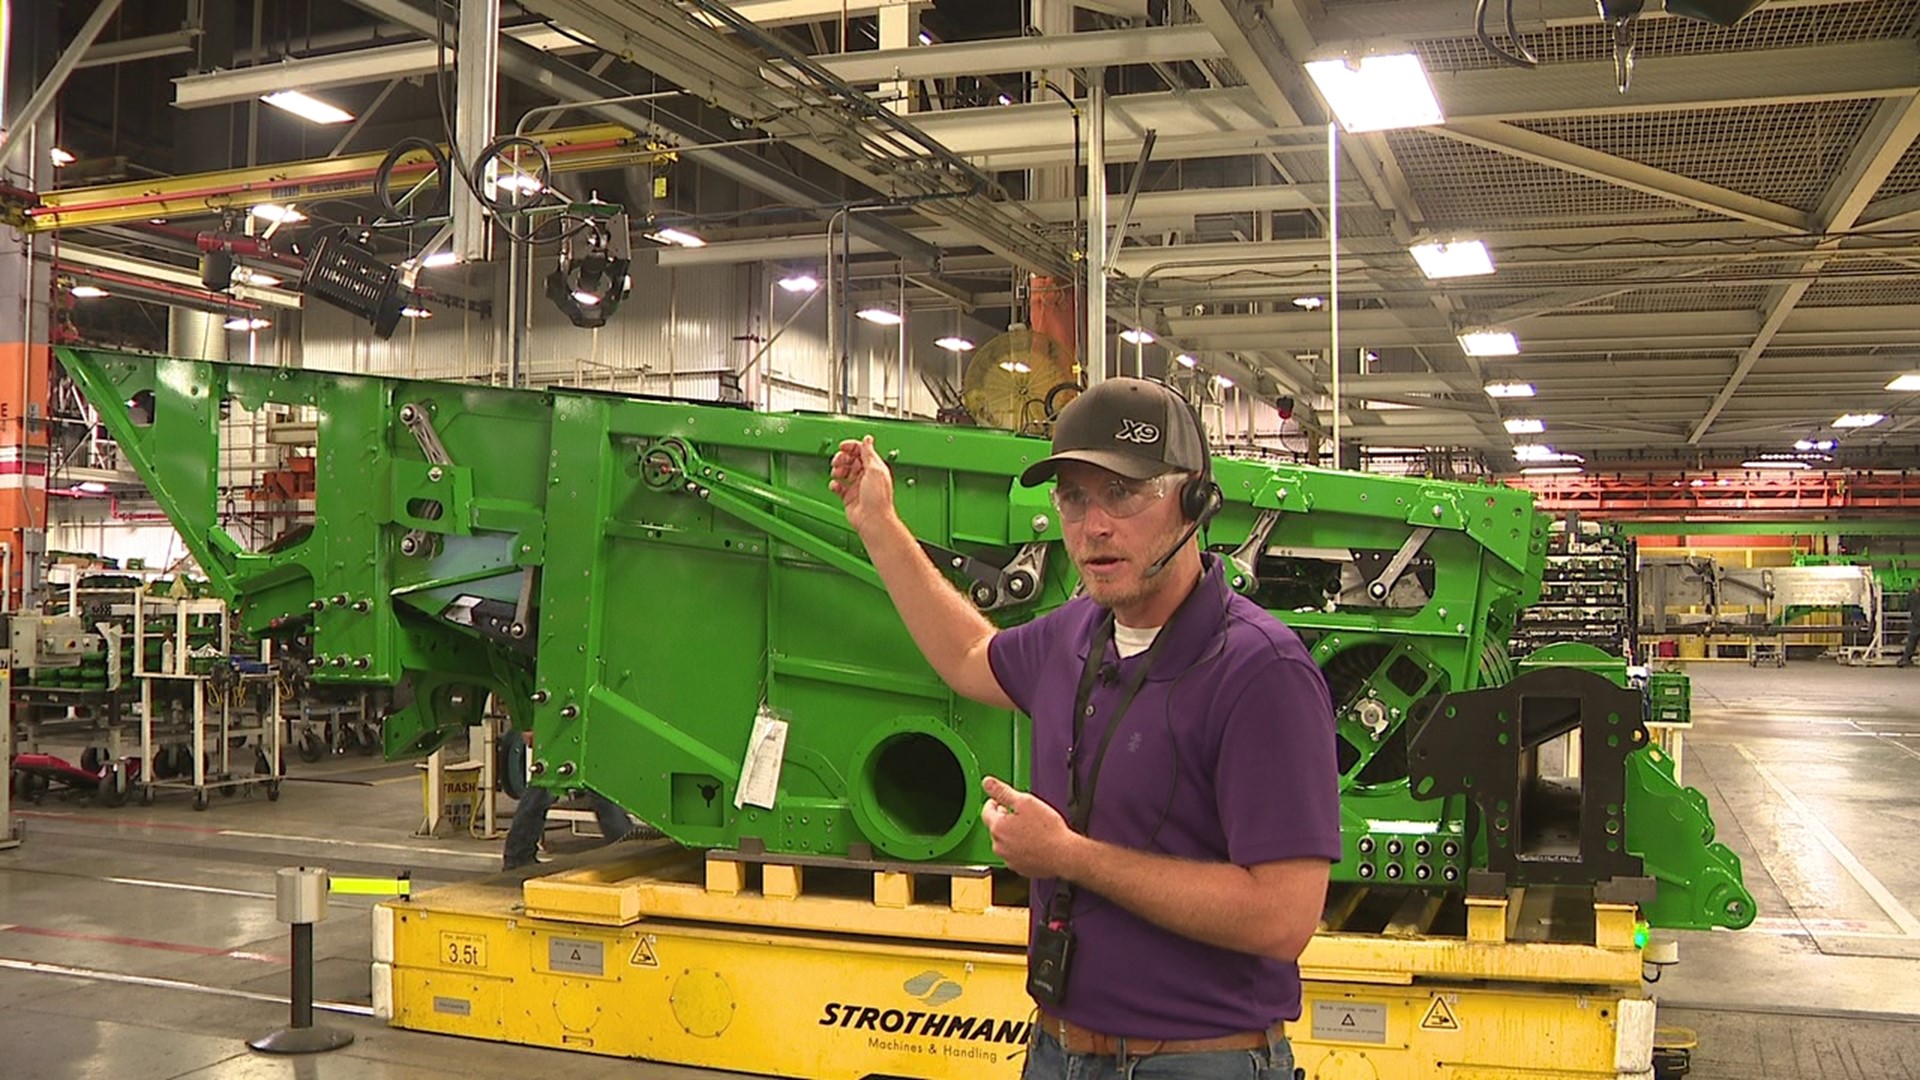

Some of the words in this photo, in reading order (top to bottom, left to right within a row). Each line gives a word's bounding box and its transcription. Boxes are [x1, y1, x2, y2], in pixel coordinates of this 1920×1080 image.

[1115, 419, 1160, 443] X9
[449, 943, 478, 966] 3.5t
[868, 1038, 923, 1053] Machines
[928, 1043, 937, 1055] &
[943, 1045, 998, 1064] Handling
